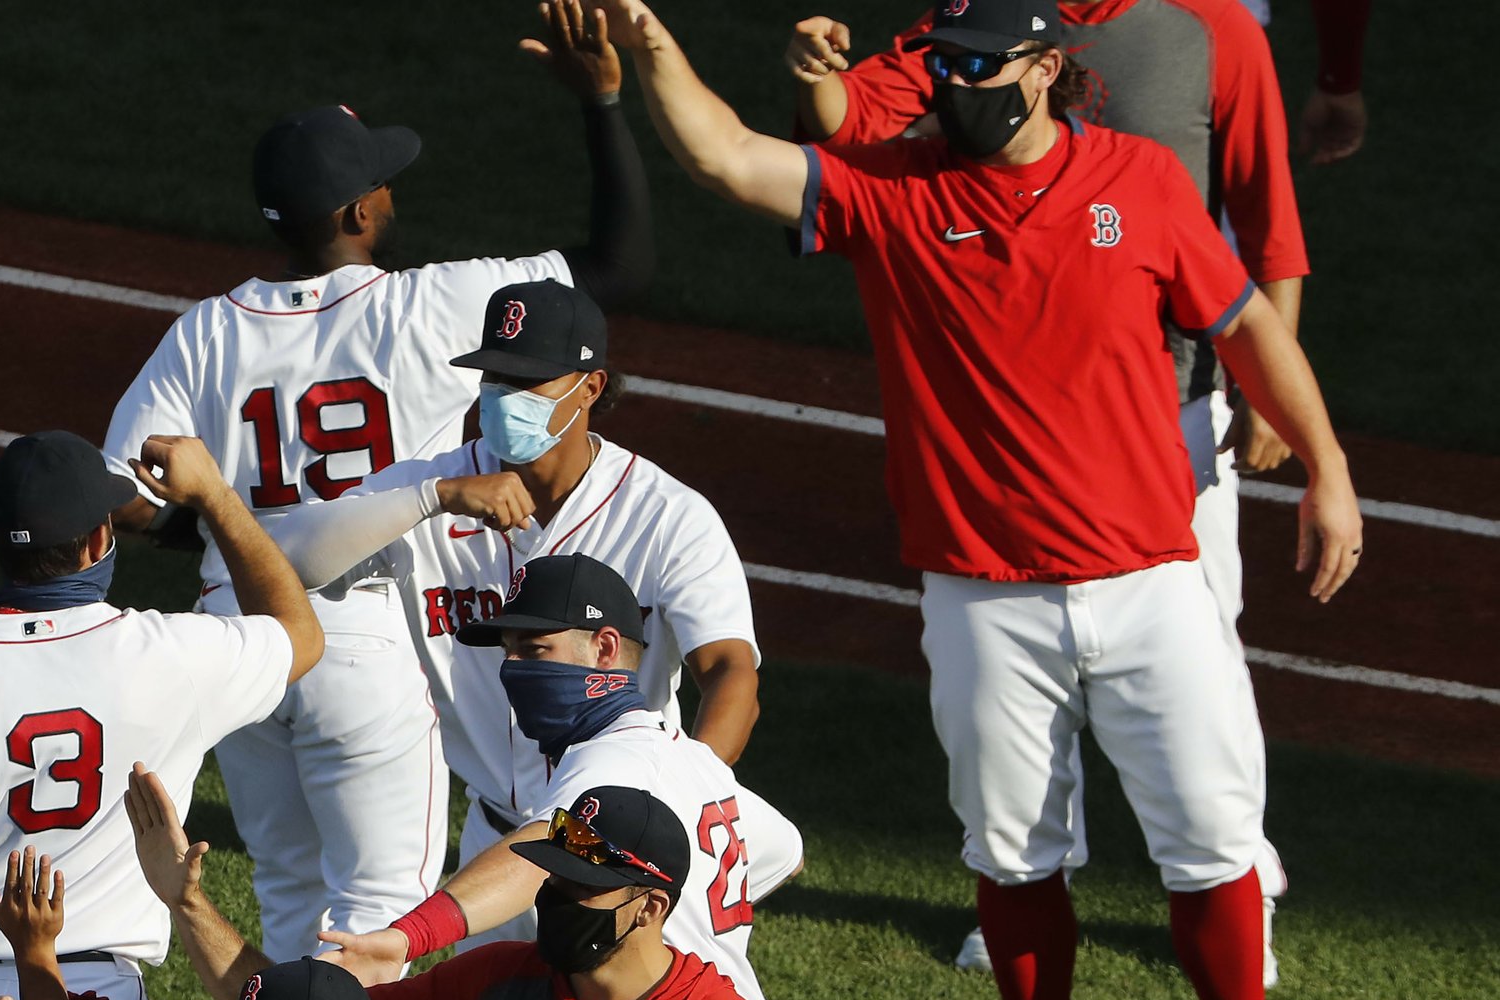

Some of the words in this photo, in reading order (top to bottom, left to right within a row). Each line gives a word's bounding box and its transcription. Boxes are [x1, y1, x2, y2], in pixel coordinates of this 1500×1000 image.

[1089, 203, 1124, 247] B
[496, 300, 527, 340] B
[240, 375, 396, 509] 19
[506, 565, 527, 602] B
[6, 706, 104, 835] 3
